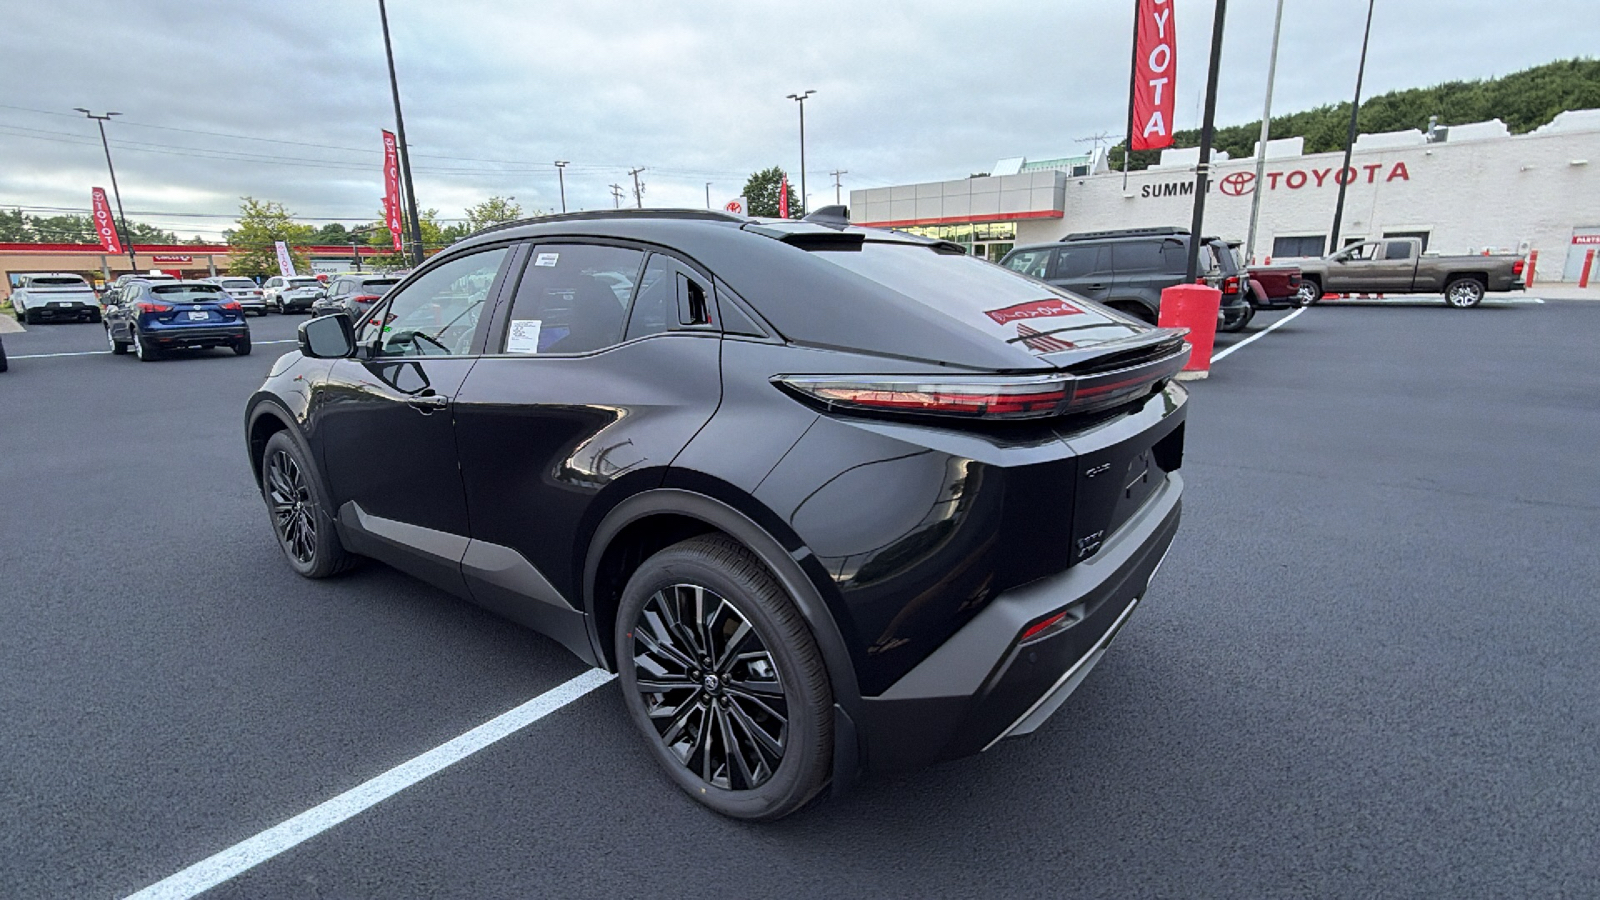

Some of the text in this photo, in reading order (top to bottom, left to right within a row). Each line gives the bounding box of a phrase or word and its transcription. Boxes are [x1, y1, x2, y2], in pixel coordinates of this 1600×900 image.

[1143, 0, 1170, 138] YOTA
[1141, 161, 1410, 198] SUMMT TOYOTA
[95, 201, 117, 252] TOYOTA
